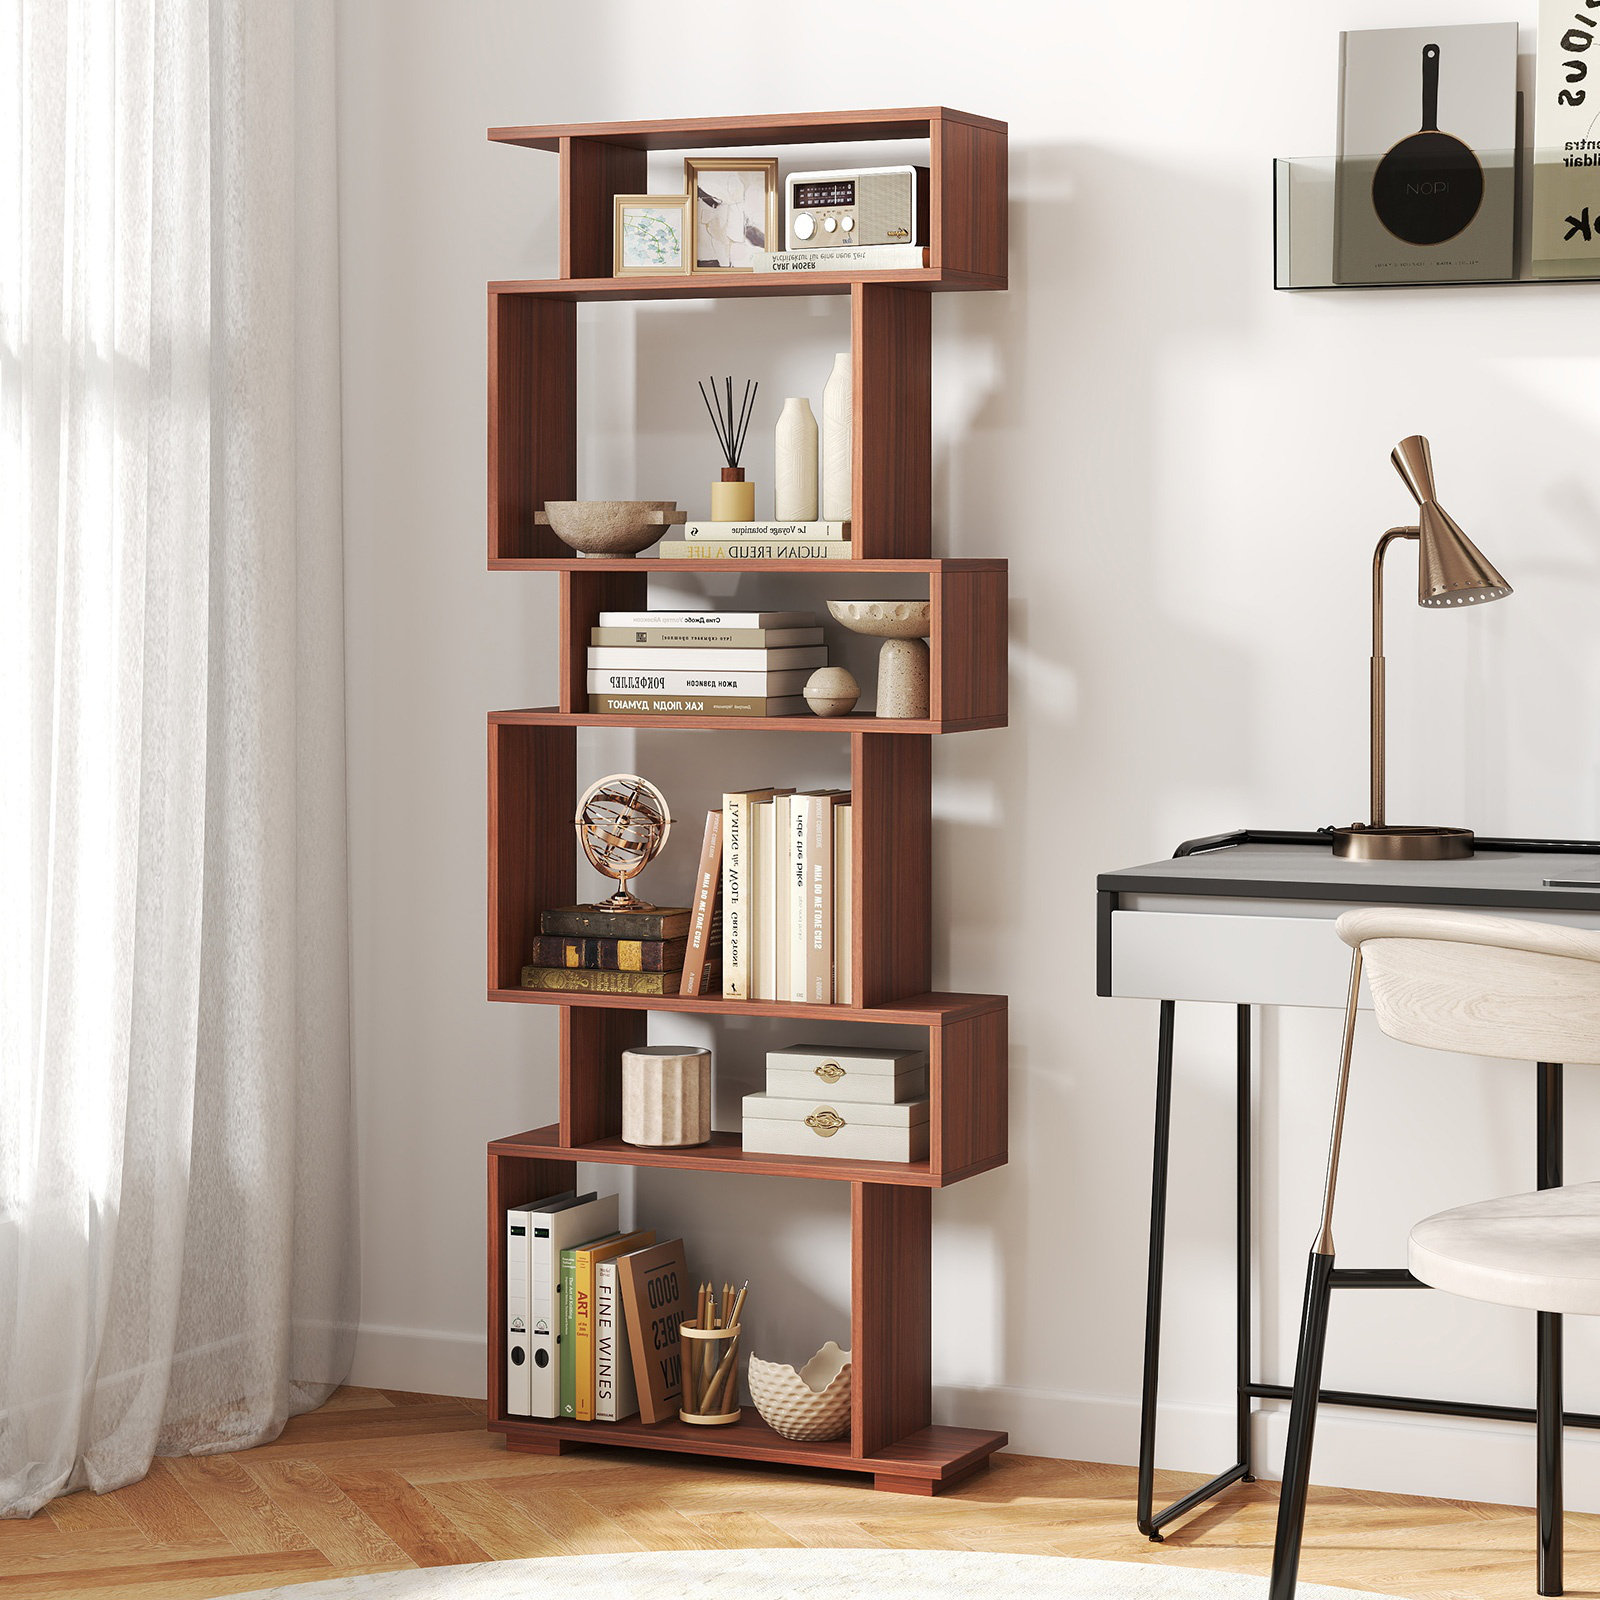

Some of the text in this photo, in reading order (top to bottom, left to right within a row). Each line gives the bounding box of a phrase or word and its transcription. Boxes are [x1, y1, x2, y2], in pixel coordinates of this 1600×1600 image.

[1406, 182, 1450, 196] NOPI
[578, 1291, 588, 1318] ART
[599, 1285, 611, 1328] FINE
[599, 1337, 611, 1399] WINES
